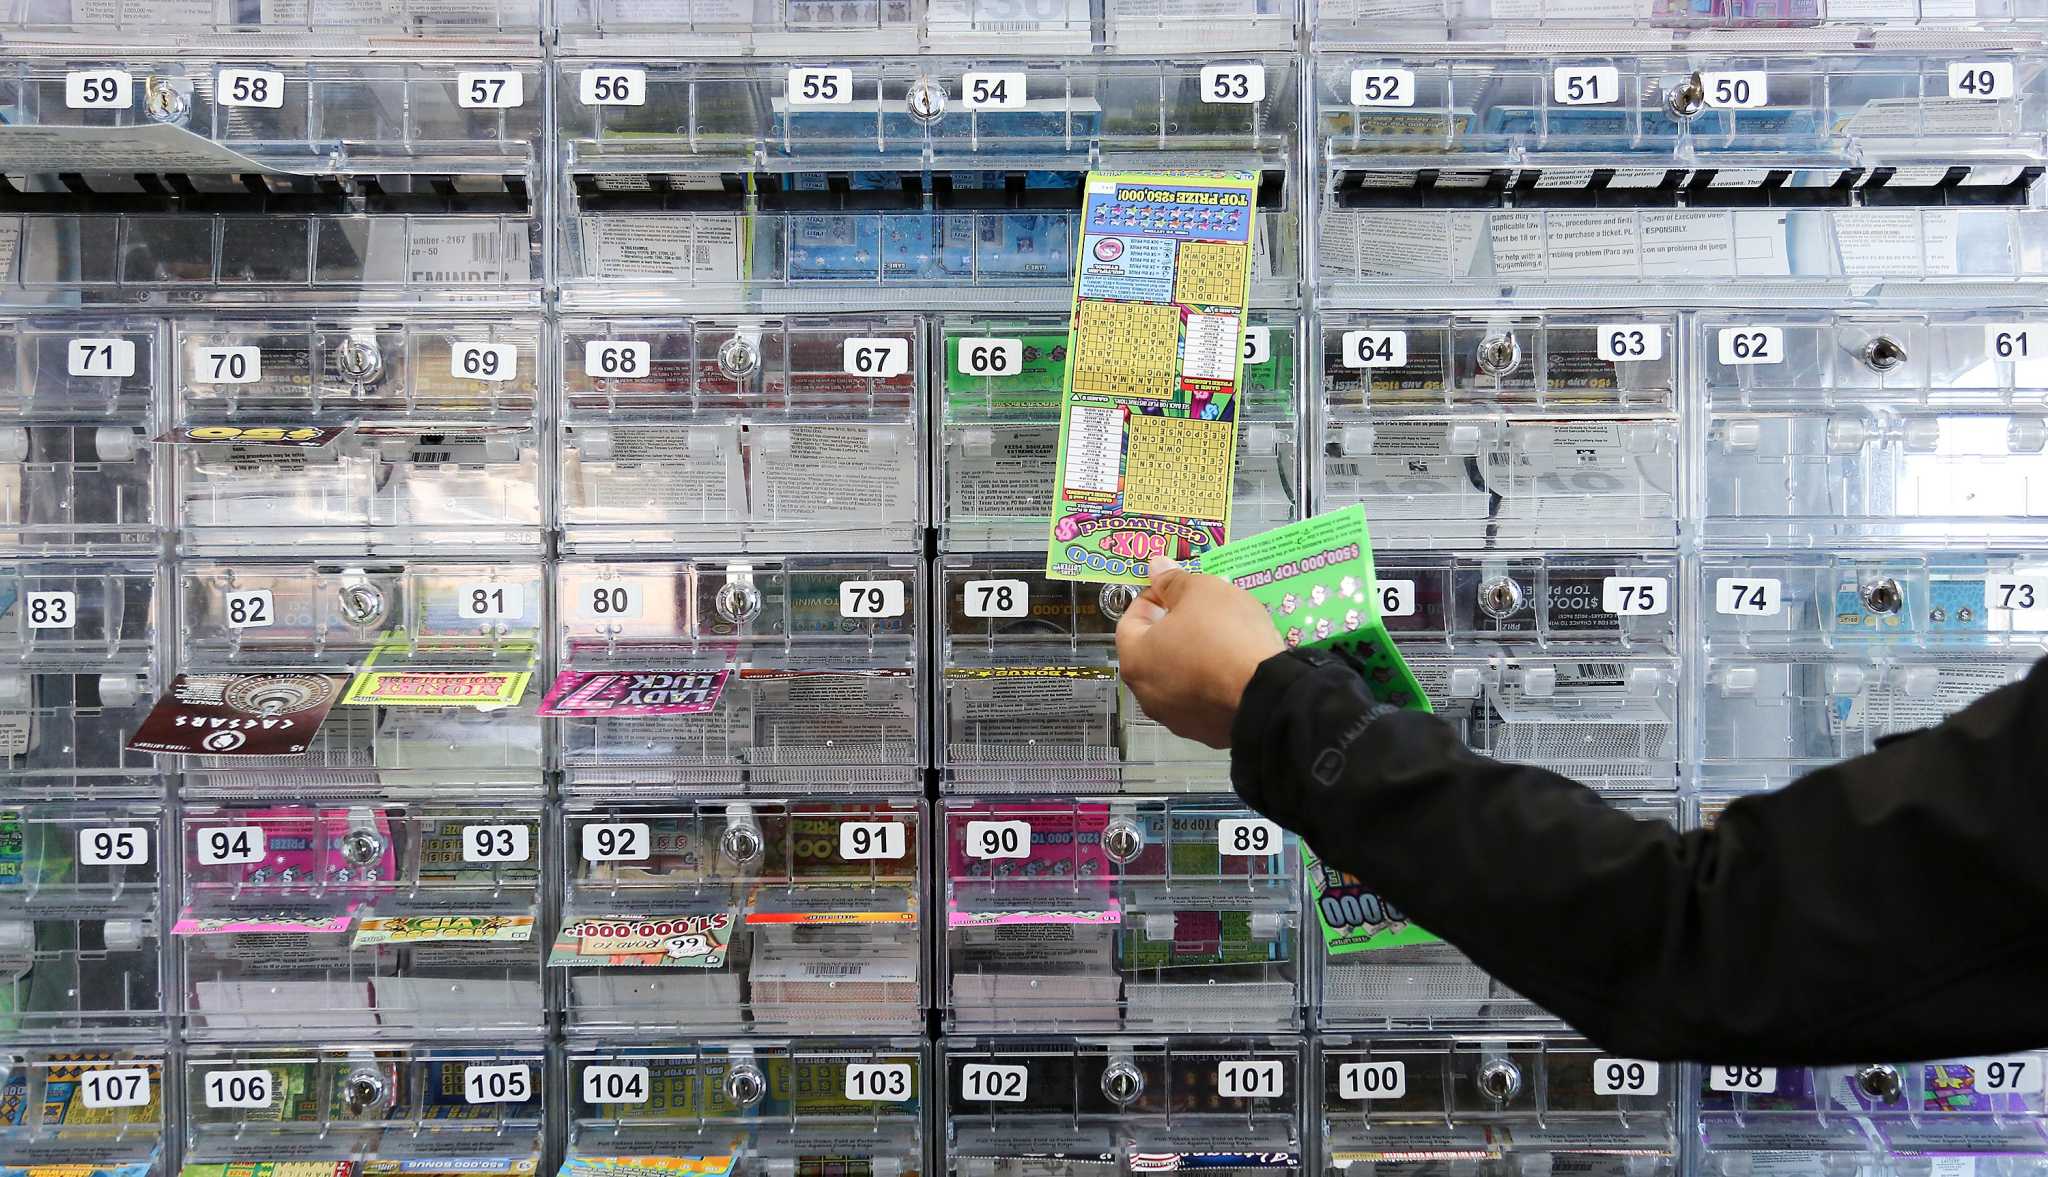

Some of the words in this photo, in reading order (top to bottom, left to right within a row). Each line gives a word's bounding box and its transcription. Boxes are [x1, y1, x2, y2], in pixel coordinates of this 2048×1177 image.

[84, 78, 117, 102] 59
[233, 77, 267, 102] 58
[472, 80, 505, 103] 57
[595, 77, 628, 100] 56
[803, 75, 837, 99] 55
[973, 80, 1007, 103] 54
[1215, 74, 1248, 98] 53
[1366, 77, 1399, 100] 52
[1568, 76, 1597, 100] 51
[1716, 80, 1749, 103] 50
[1960, 70, 1994, 94] 49
[1117, 189, 1175, 203] $250,000!
[1176, 192, 1218, 205] PRIZE
[1218, 194, 1247, 205] TOP
[1244, 335, 1256, 359] 5
[1359, 337, 1393, 361] 64
[1611, 331, 1644, 355] 63
[1734, 333, 1767, 358] 62
[1997, 332, 2026, 357] 61
[81, 345, 111, 369] 71
[211, 354, 245, 378] 70
[464, 349, 498, 375] 69
[602, 349, 635, 372] 68
[856, 348, 890, 372] 67
[972, 347, 1006, 371] 66
[1078, 518, 1209, 545] Cashword
[1112, 531, 1165, 559] 50X
[1299, 541, 1360, 571] $500,000
[1274, 561, 1299, 580] TOP
[473, 589, 502, 613] 81
[594, 588, 627, 613] 80
[850, 588, 884, 612] 79
[978, 586, 1012, 611] 78
[1378, 587, 1399, 611] 6
[1563, 585, 1590, 595] TOP
[1620, 586, 1654, 610] 75
[1733, 586, 1766, 610] 74
[2000, 585, 2034, 608] 73
[32, 599, 66, 623] 83
[231, 597, 265, 623] 82
[555, 675, 620, 709] 7
[629, 674, 713, 690] LUCK
[620, 689, 707, 705] LADY
[175, 715, 295, 729] CAESARS
[1192, 818, 1210, 831] TOP
[95, 833, 133, 859] 95
[212, 831, 251, 859] 94
[476, 830, 514, 856] 93
[598, 829, 635, 855] 92
[853, 827, 886, 854] 91
[983, 828, 1017, 854] 90
[1234, 826, 1268, 850] 89
[420, 917, 473, 929] VIP
[592, 942, 612, 951] TO
[616, 940, 661, 949] ROAD
[672, 938, 700, 949] 66
[472, 1072, 524, 1098] 105
[590, 1074, 642, 1098] 104
[853, 1071, 904, 1094] 103
[970, 1071, 1021, 1096] 102
[1225, 1068, 1273, 1092] 101
[1347, 1067, 1397, 1092] 100
[1607, 1063, 1644, 1090] 99
[1725, 1066, 1761, 1087] 98
[1988, 1062, 2025, 1088] 97
[89, 1076, 140, 1101] 107
[212, 1077, 264, 1102] 106
